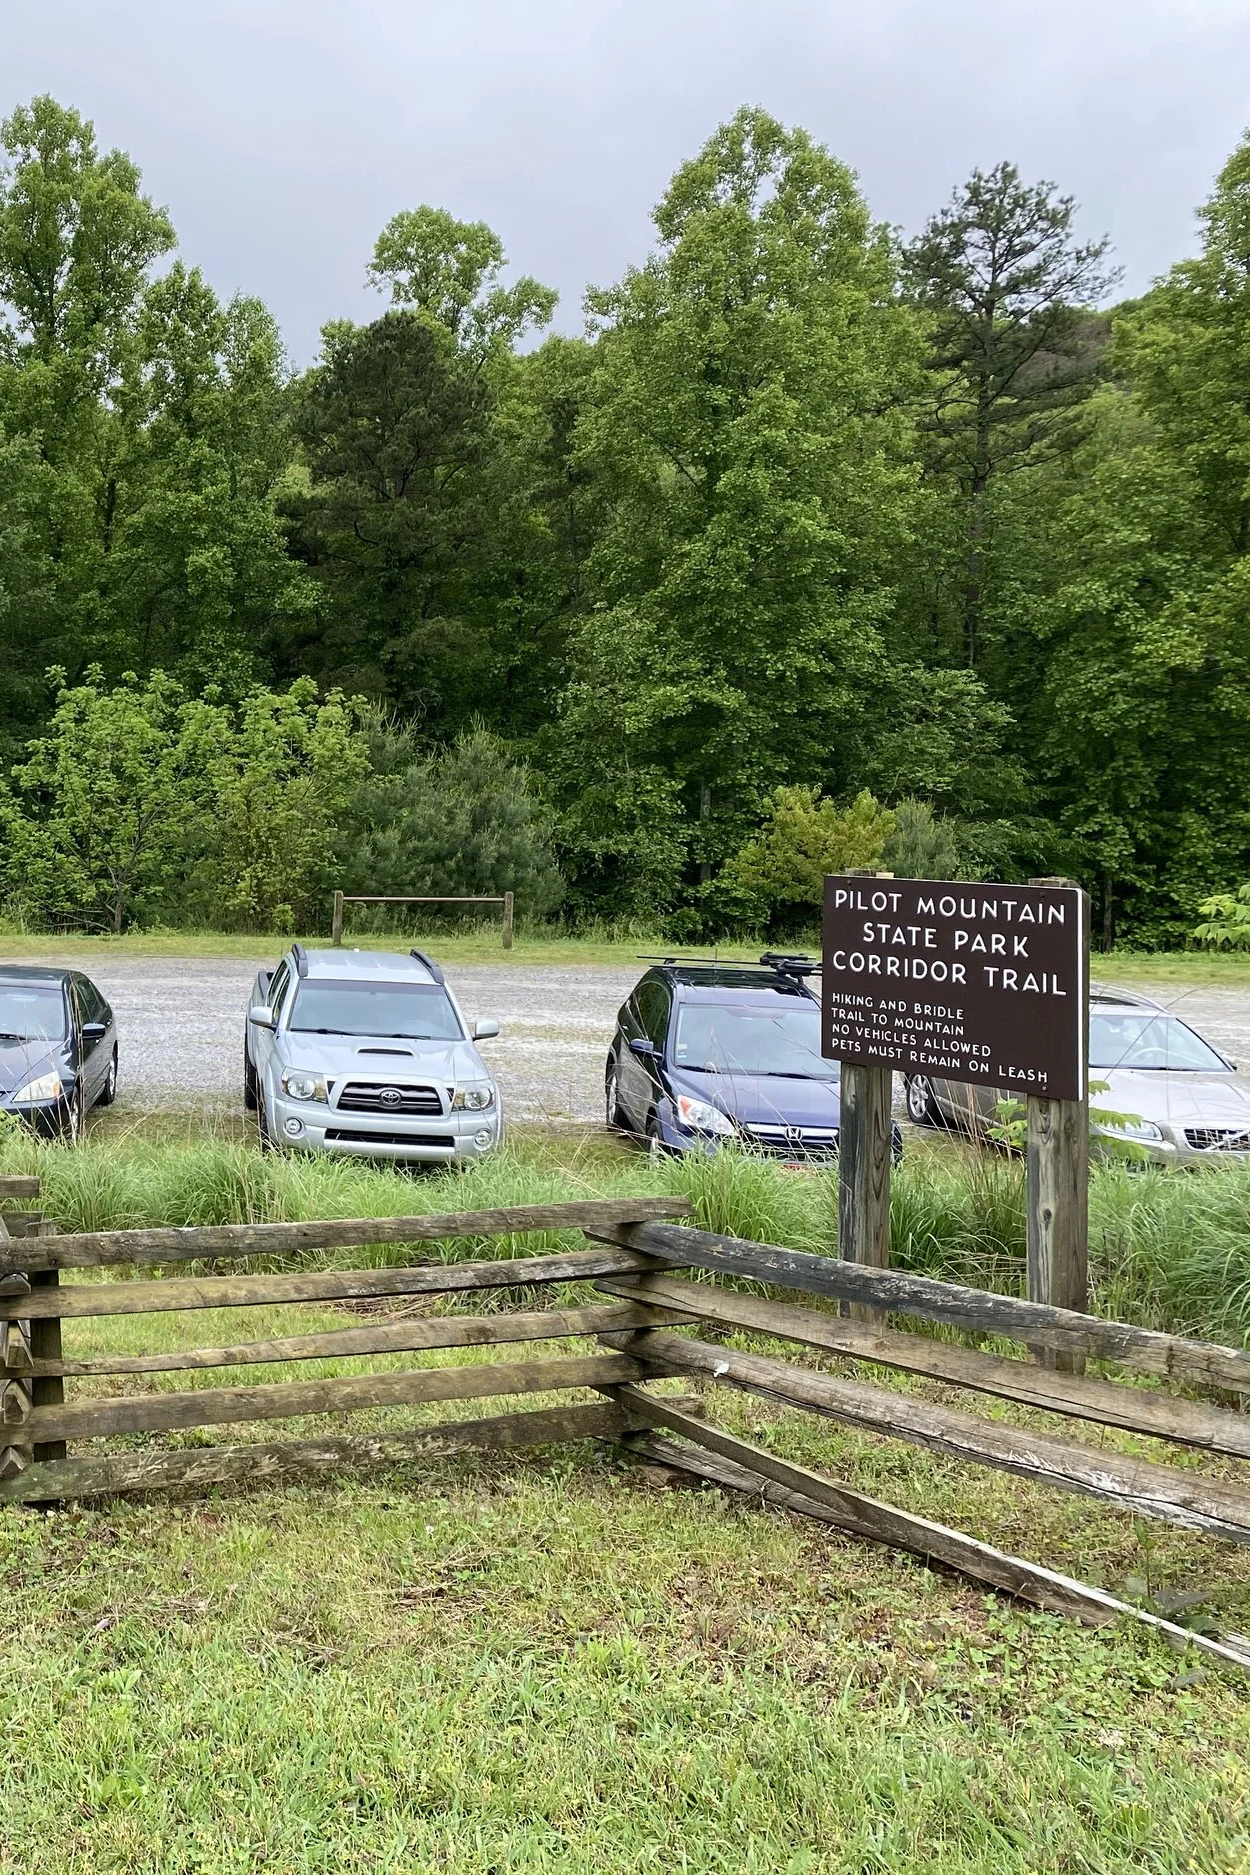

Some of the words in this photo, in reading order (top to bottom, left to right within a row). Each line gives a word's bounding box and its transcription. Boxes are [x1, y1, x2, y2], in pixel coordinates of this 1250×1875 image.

[835, 889, 902, 912] PILOT
[916, 896, 1064, 924] MOUNTAIN
[863, 922, 937, 948] STATE
[954, 930, 1029, 958] PARK
[833, 950, 966, 985] CORRIDOR
[984, 966, 1067, 996] TRAIL
[831, 1007, 865, 1022] TRAIL
[871, 1013, 888, 1025] TO
[894, 1018, 964, 1036] MOUNTAIN
[832, 992, 873, 1007] HIKING
[879, 1000, 906, 1012] AND
[914, 1003, 964, 1020] BRIDLE
[832, 1024, 850, 1035] NO
[855, 1026, 916, 1046] VEHICLES
[924, 1038, 991, 1057] ALLOWED
[832, 1038, 861, 1052] PETS
[868, 1045, 903, 1059] MUST
[910, 1050, 960, 1068] REMAIN
[968, 1060, 989, 1072] ON
[999, 1065, 1047, 1083] LEASH
